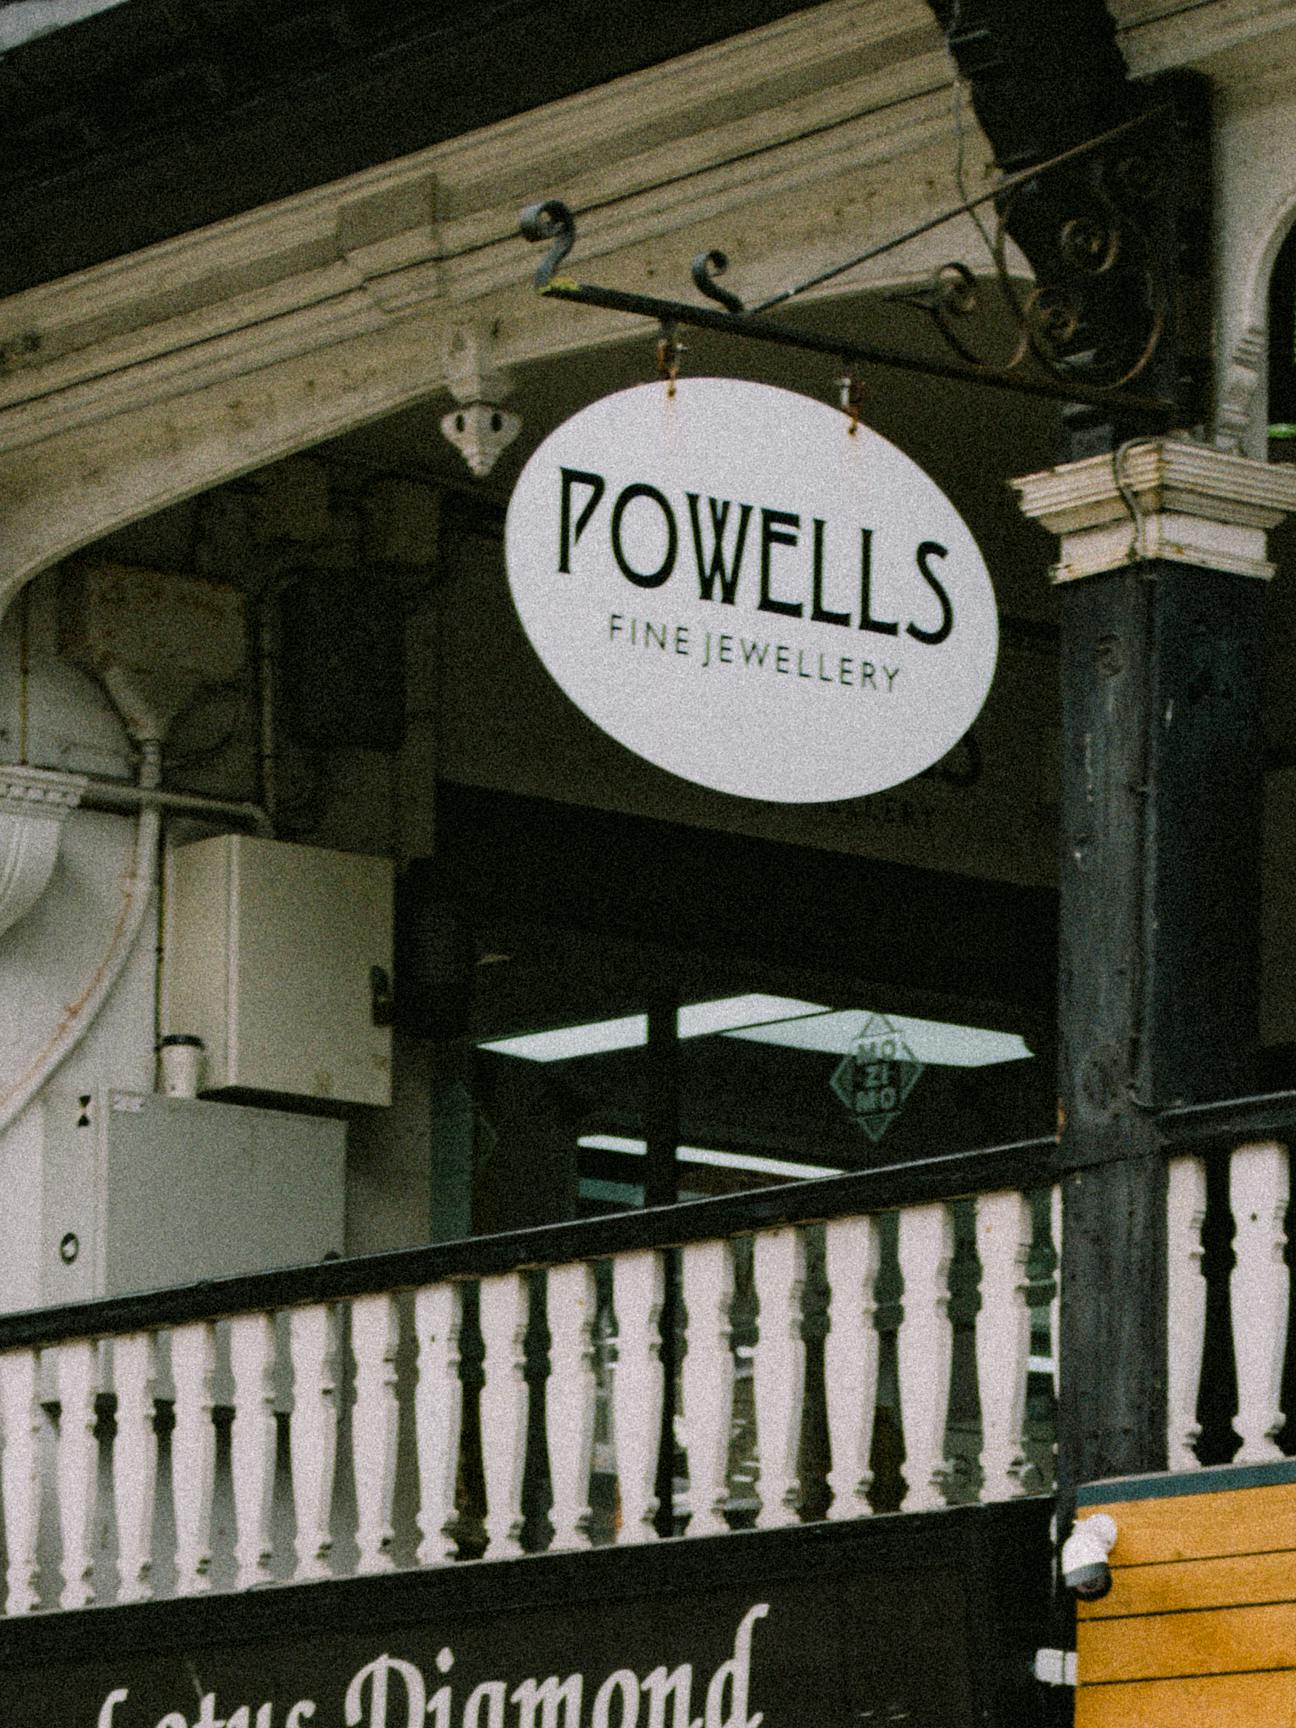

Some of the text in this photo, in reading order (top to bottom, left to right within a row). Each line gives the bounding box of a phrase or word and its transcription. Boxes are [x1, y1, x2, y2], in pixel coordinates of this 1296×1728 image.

[558, 466, 954, 646] POWELLS
[608, 613, 900, 692] FINE JEWELLERY
[857, 1038, 897, 1066] MO
[856, 1086, 897, 1113] MO
